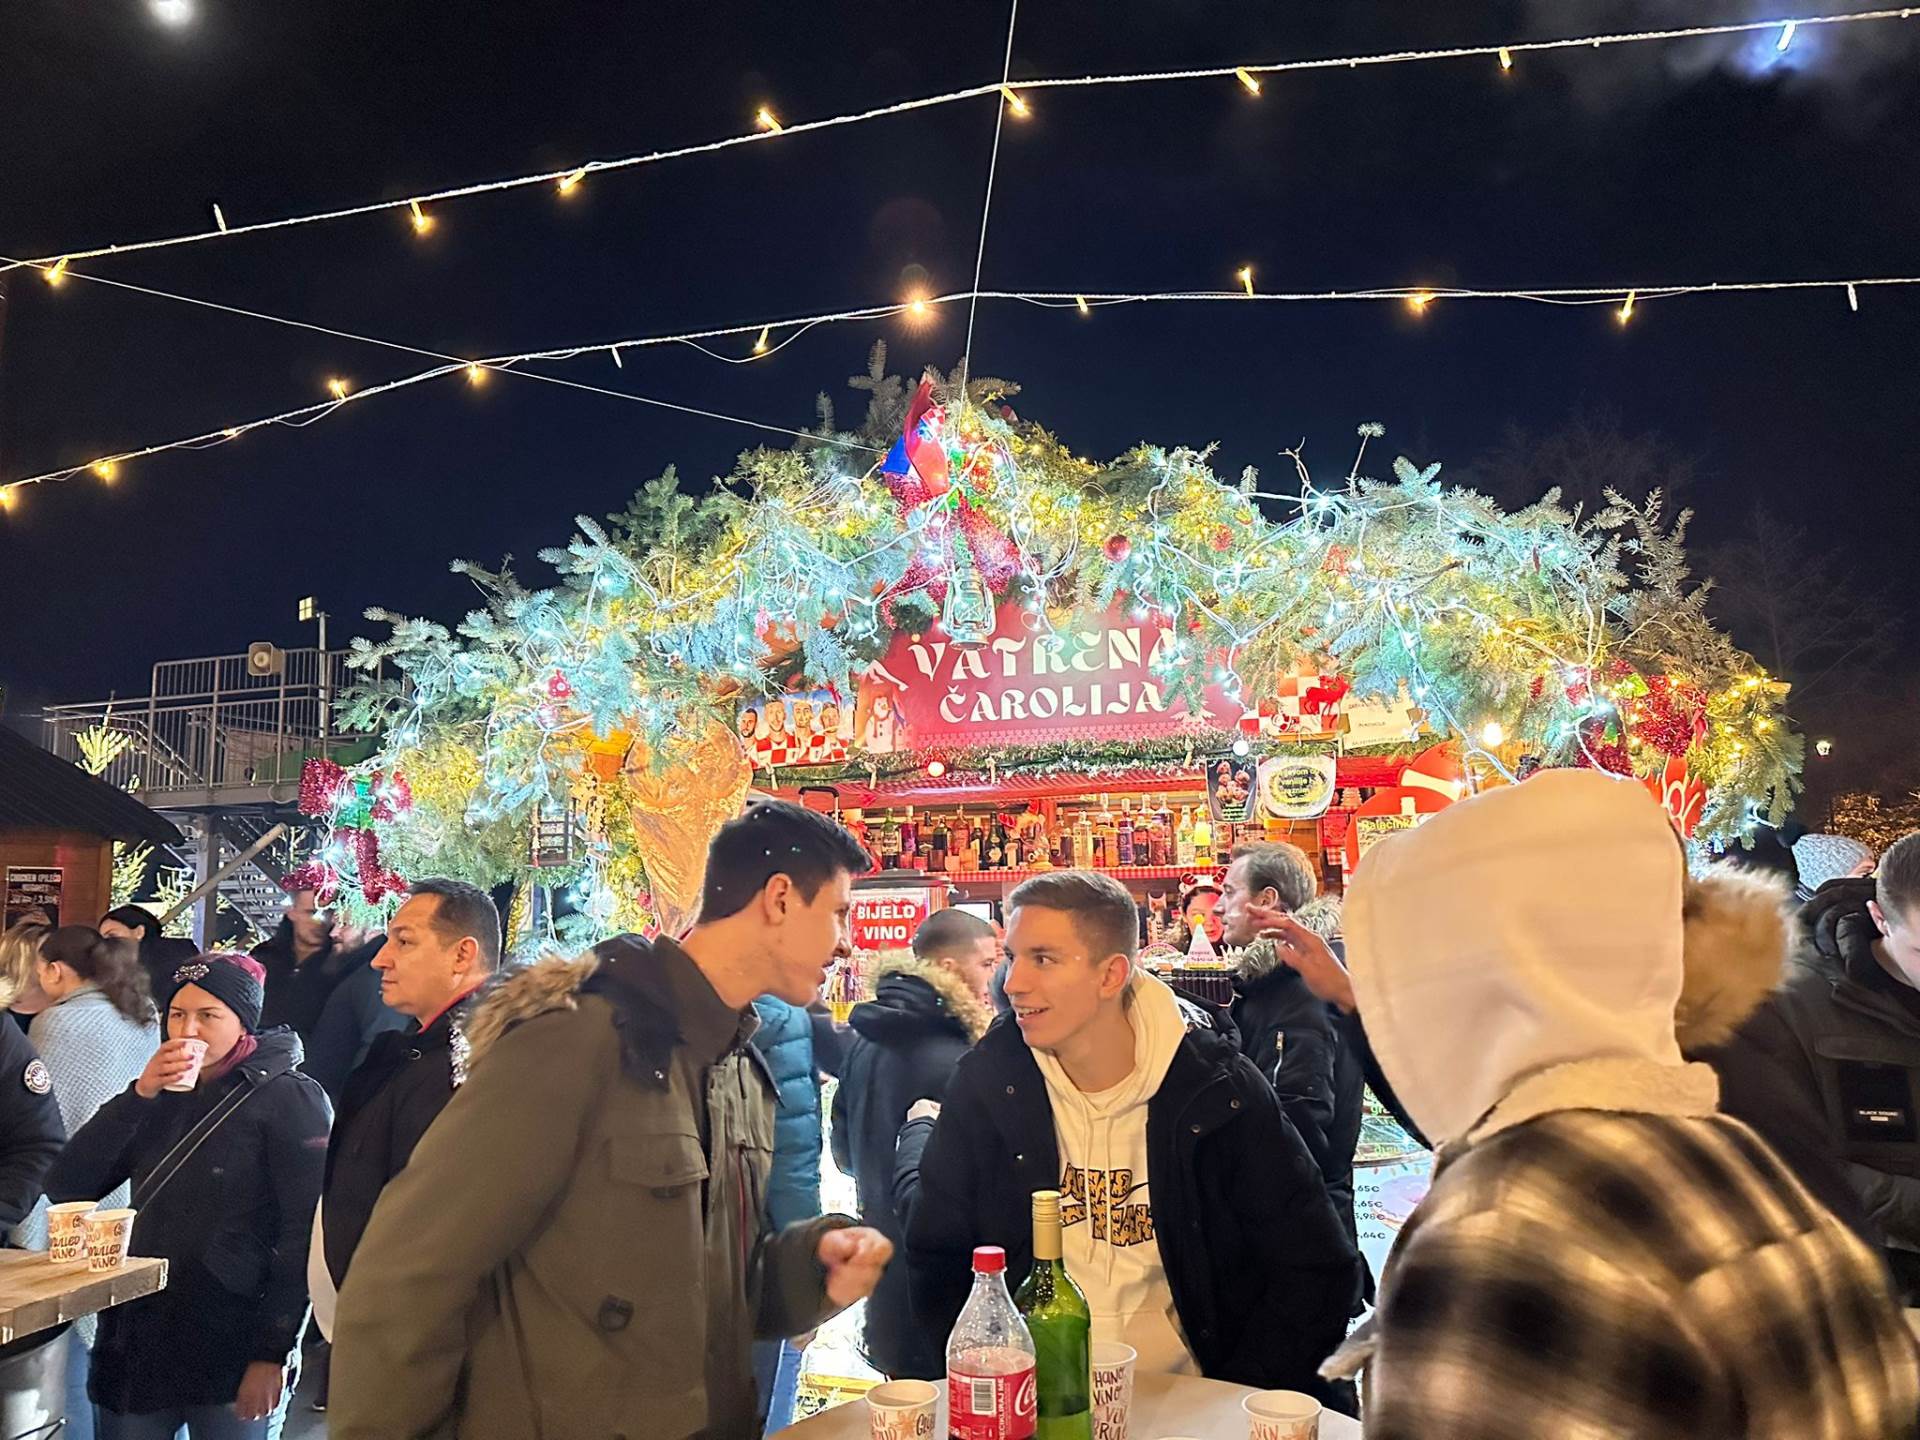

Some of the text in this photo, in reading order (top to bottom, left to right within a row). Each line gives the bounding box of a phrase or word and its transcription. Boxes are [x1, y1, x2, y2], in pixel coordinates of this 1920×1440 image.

[939, 681, 1168, 723] ČAROLIJA
[857, 904, 916, 920] BIJELO
[863, 925, 907, 940] VINO
